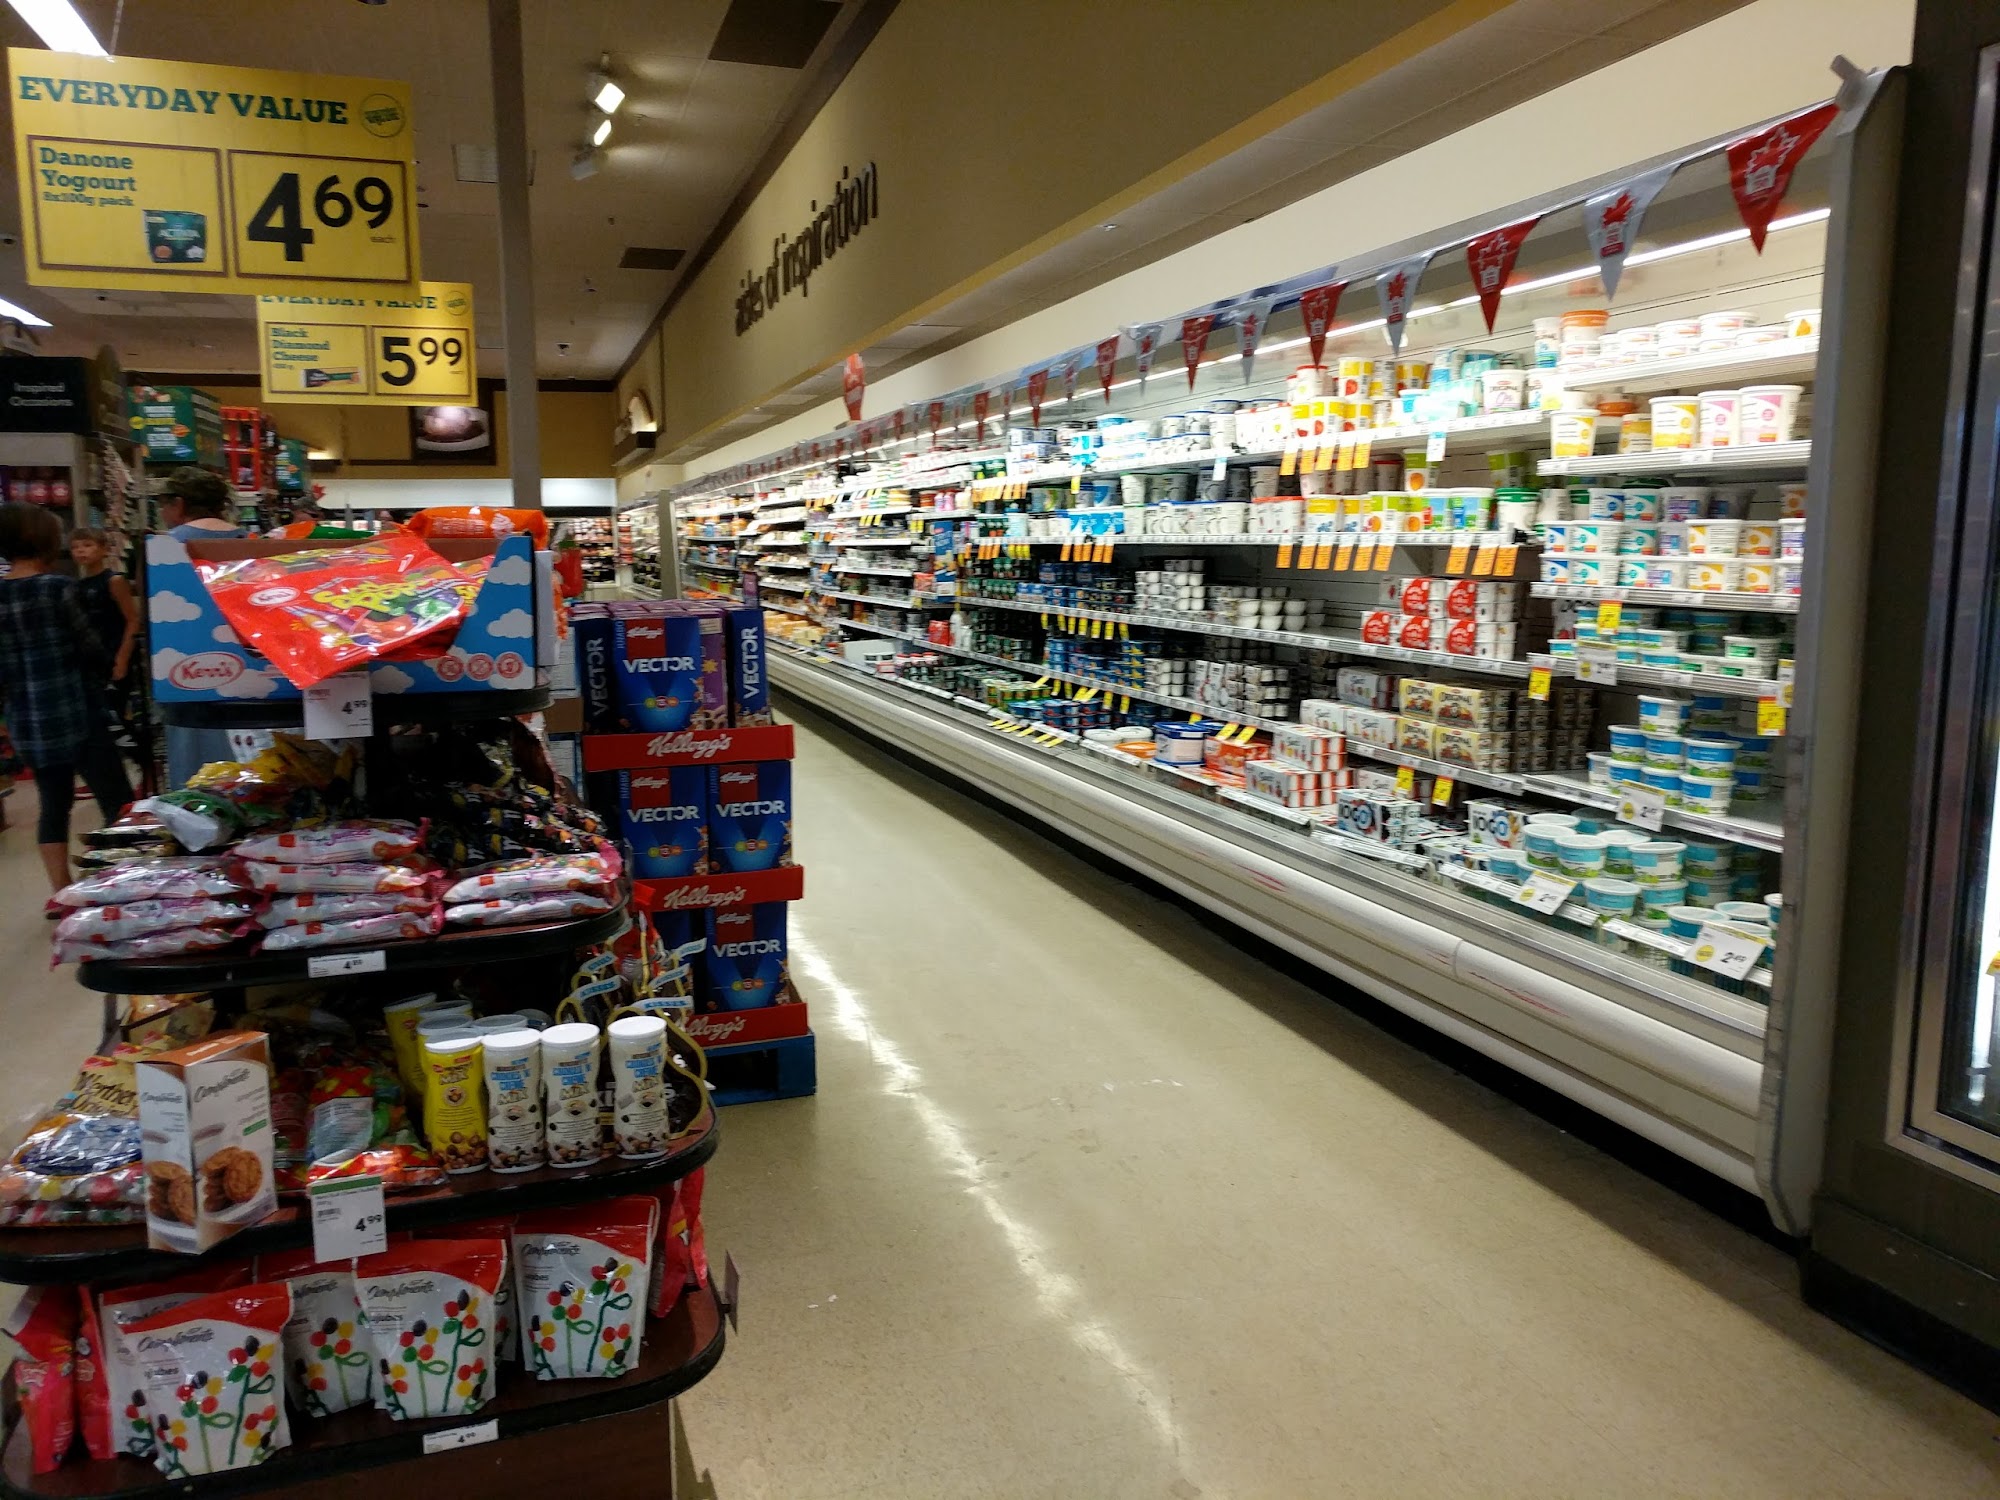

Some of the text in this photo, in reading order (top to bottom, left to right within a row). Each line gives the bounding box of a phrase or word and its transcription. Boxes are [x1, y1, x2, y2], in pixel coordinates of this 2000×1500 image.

[18, 76, 221, 115] EVERYDAY
[227, 93, 348, 125] VALUE
[39, 147, 133, 169] Danone
[41, 169, 137, 192] Yogourt
[782, 162, 878, 298] inspiration
[622, 656, 696, 674] VECTOR
[741, 626, 761, 699] VECTOR
[586, 637, 611, 717] VECTOR
[646, 732, 733, 759] Kellogg's
[627, 805, 700, 823] VECTOR
[715, 800, 786, 818] VECTOR
[663, 884, 747, 909] Kellogg's
[712, 939, 782, 958] VECTOR
[676, 1016, 747, 1041] ellogg's
[72, 1071, 138, 1106] Werther
